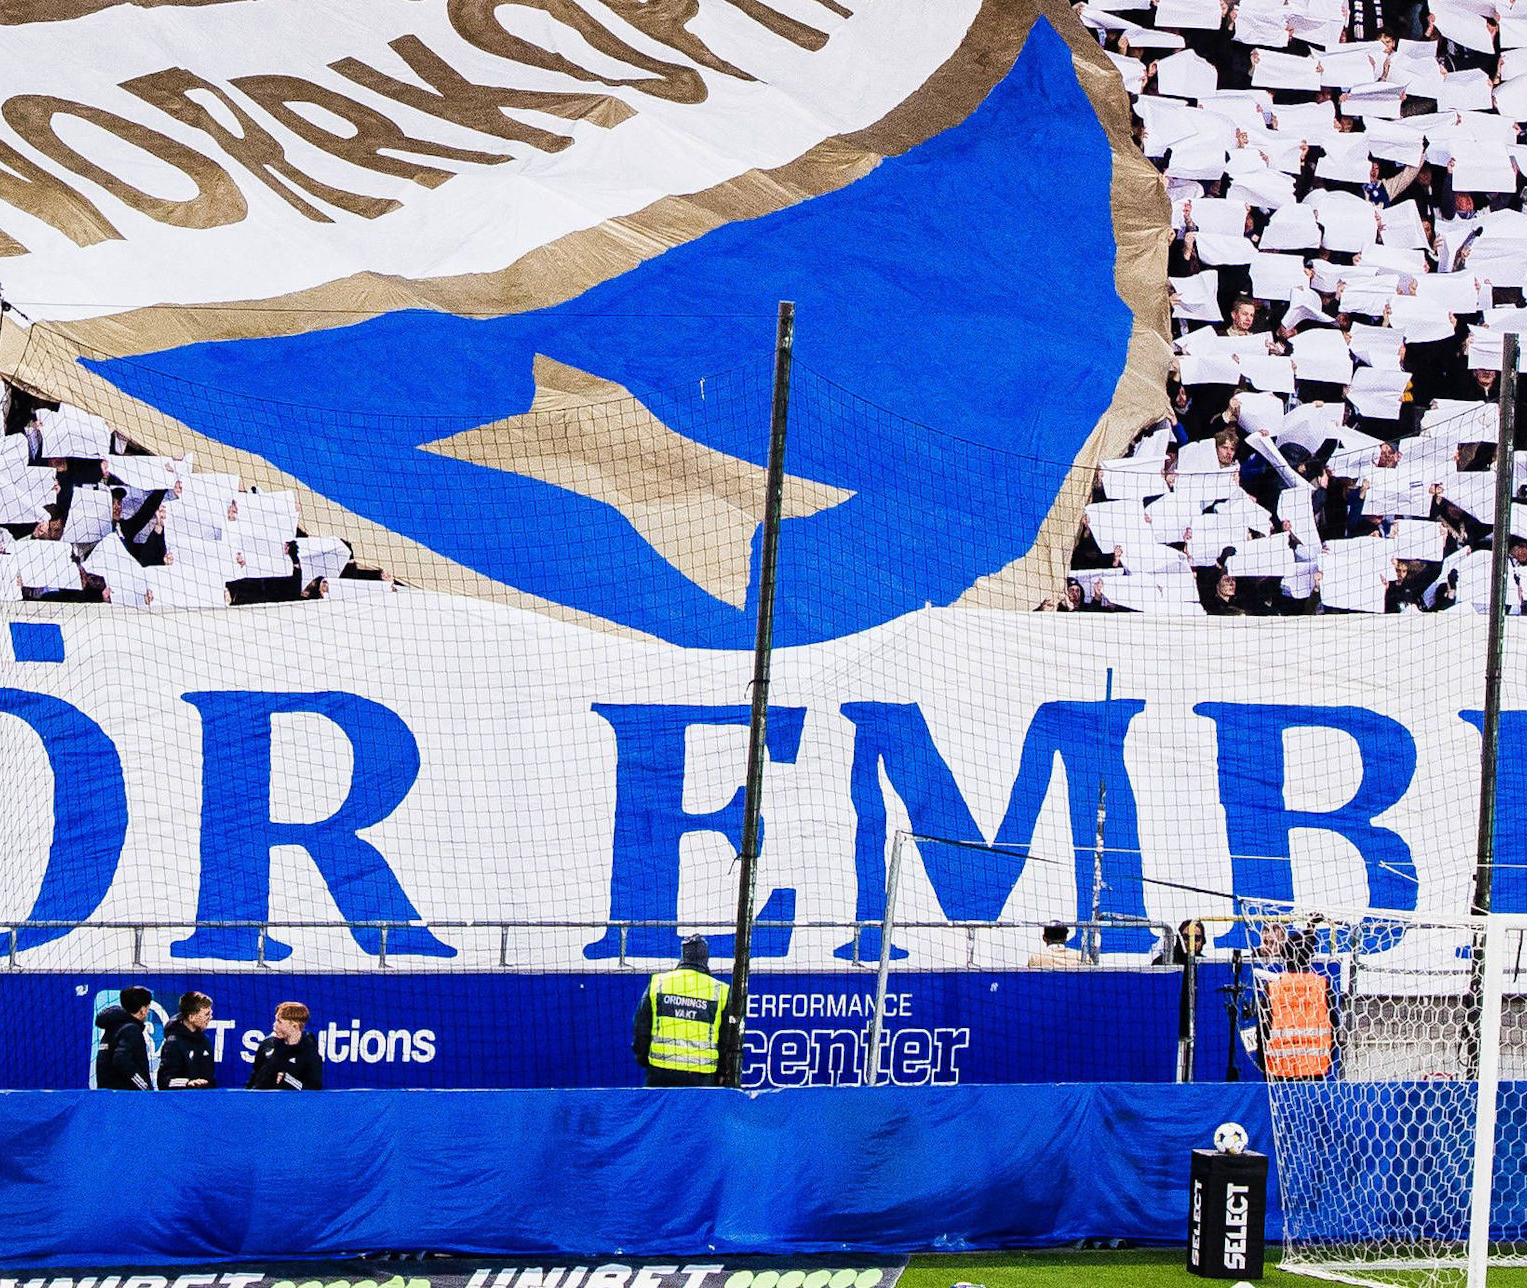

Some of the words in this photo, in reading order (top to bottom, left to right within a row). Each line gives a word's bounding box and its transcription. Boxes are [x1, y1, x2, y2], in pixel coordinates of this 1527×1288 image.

[745, 993, 913, 1017] ERFORMANCE
[240, 1019, 436, 1064] stions
[1191, 1179, 1203, 1267] SELECT
[1224, 1182, 1250, 1270] SELECT
